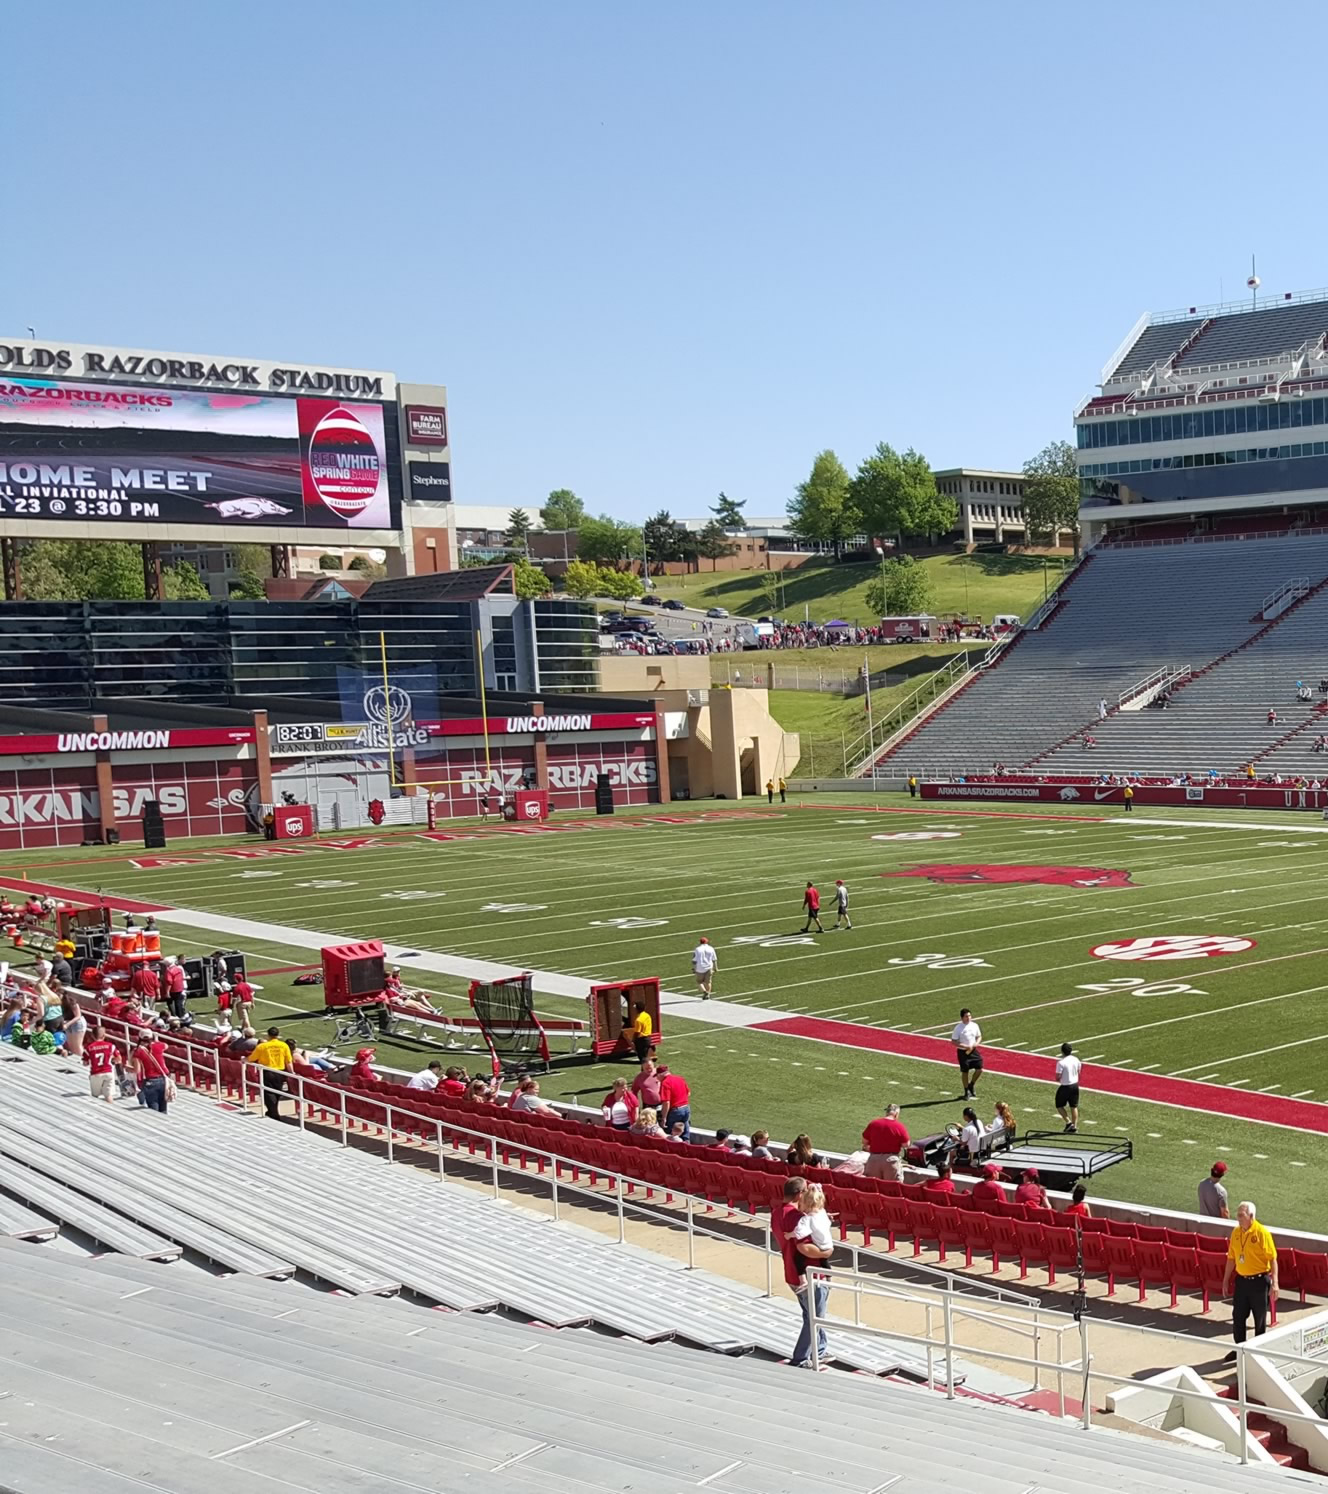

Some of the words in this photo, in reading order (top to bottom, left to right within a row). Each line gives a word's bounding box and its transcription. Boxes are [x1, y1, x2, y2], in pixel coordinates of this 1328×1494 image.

[86, 352, 261, 385] RAZORBACK
[272, 368, 383, 395] STADIUM
[412, 421, 442, 430] BUREAU
[337, 453, 379, 470] WHITE
[111, 467, 212, 492] MEET
[312, 467, 351, 479] SPRING
[413, 474, 449, 486] Stephens
[22, 486, 129, 500] INVIATIONAL
[15, 498, 41, 514] 23
[50, 500, 67, 514] @
[75, 500, 122, 516] 3:30
[130, 503, 160, 517] PM
[507, 714, 592, 733] UNCOMMON
[57, 730, 170, 752] UNCOMMON
[280, 726, 321, 741] 82:07
[271, 743, 311, 754] FRANK
[938, 786, 1040, 797] ARKANSASRAZORBACKS.COM
[527, 804, 540, 816] ups
[287, 820, 303, 835] ups
[588, 916, 671, 929] 50
[730, 933, 816, 948] 40
[887, 953, 986, 970] 30
[1075, 977, 1193, 998] 20
[95, 1052, 105, 1067] 7
